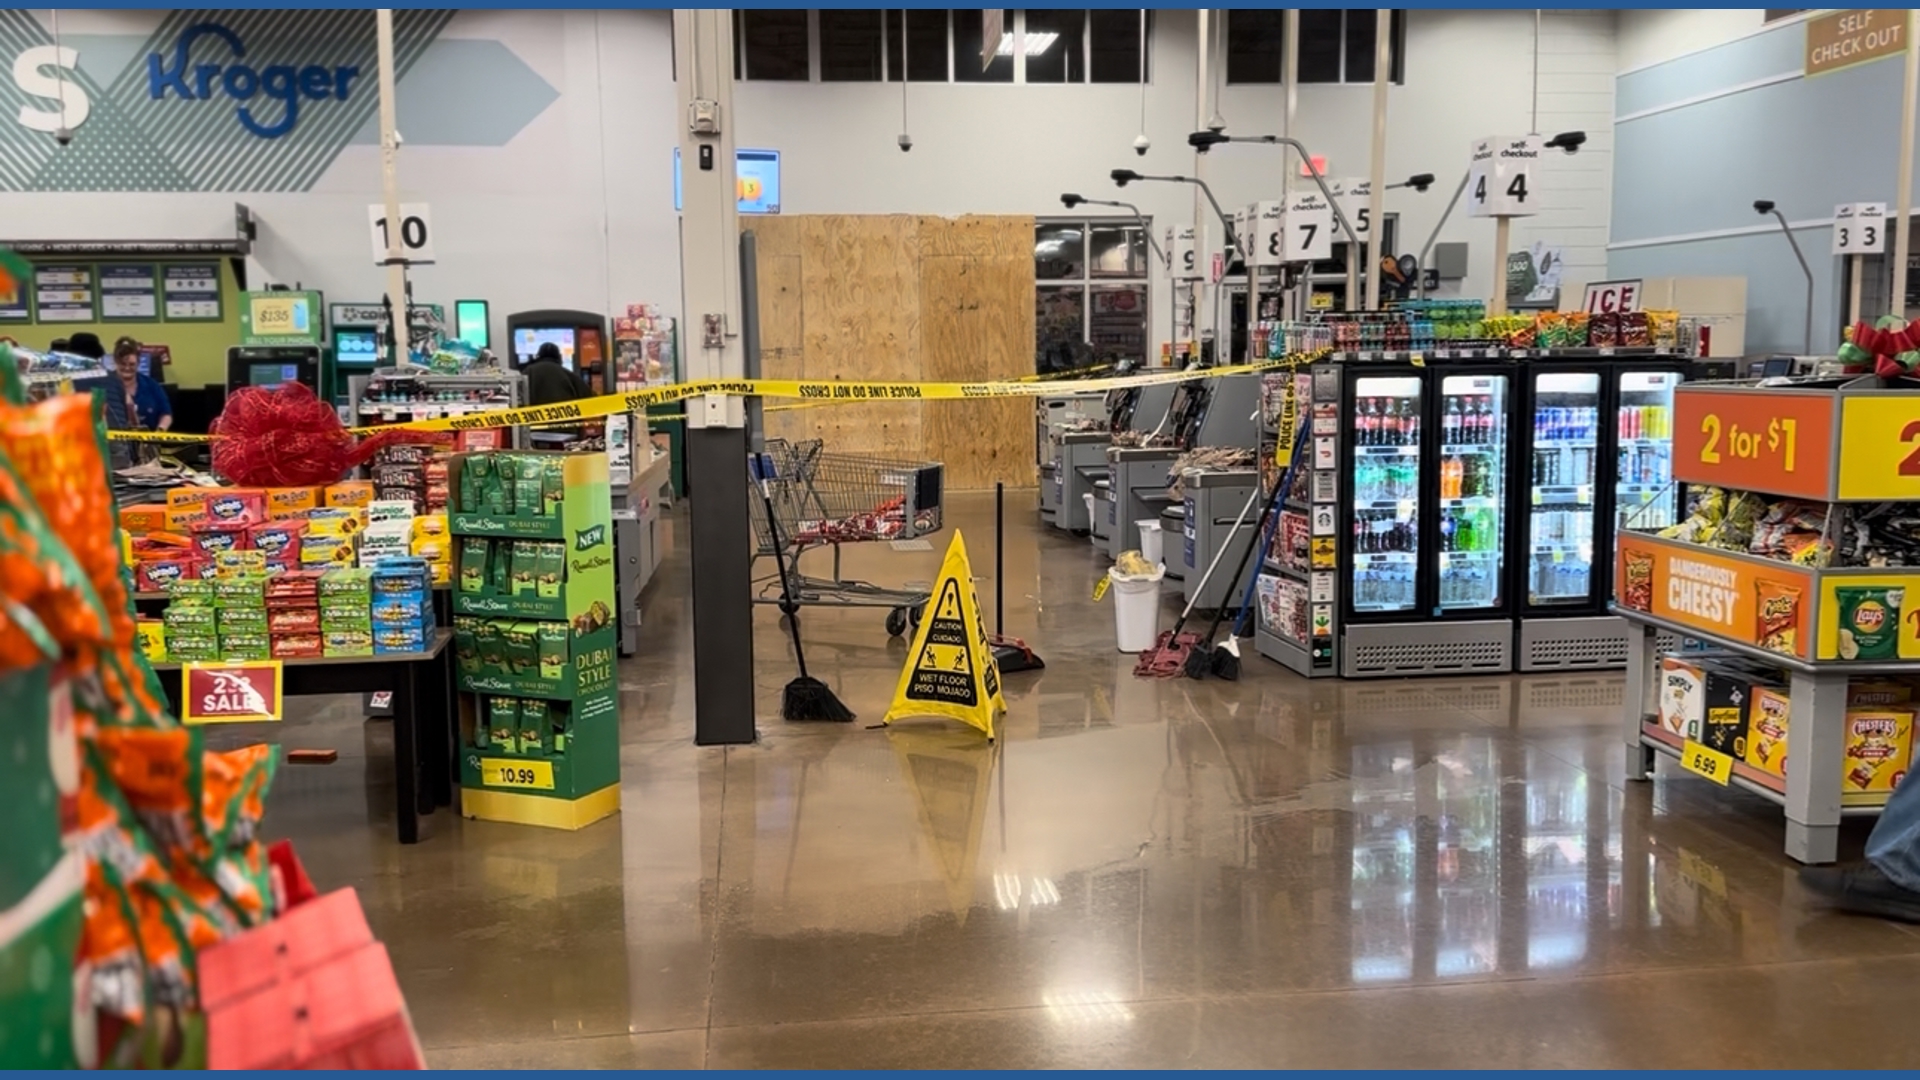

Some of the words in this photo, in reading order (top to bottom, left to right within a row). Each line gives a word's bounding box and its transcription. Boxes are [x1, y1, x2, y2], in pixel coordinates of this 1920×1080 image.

[1838, 10, 1873, 35] SELF
[1811, 36, 1861, 64] CHECK
[1865, 25, 1901, 50] OUT
[148, 22, 359, 139] Kroger
[1500, 149, 1538, 158] checkout
[1475, 174, 1487, 204] 4
[1506, 173, 1528, 203] 4
[1292, 203, 1327, 211] checkout
[1356, 208, 1370, 232] 5
[376, 216, 427, 249] 10
[1299, 224, 1317, 250] 7
[1839, 227, 1849, 247] 3
[1863, 226, 1876, 246] 3
[1588, 285, 1635, 313] ICE
[259, 309, 290, 324] $135
[799, 384, 831, 398] CROSS
[833, 385, 852, 398] NOT
[853, 385, 867, 398] DO
[867, 386, 889, 398] LINE
[889, 386, 922, 398] POLICE
[505, 412, 520, 425] DO
[521, 408, 546, 423] LINE
[545, 404, 582, 420] POLICE
[1283, 400, 1295, 419] LINE
[485, 414, 505, 426] NOT
[1280, 421, 1293, 450] POLICE
[1700, 414, 1721, 464] 2
[1729, 424, 1761, 459] for
[1768, 417, 1796, 472] $1
[370, 506, 405, 515] Junior
[580, 528, 602, 549] NEW
[1670, 556, 1738, 589] DANGEROUSLY
[1669, 576, 1737, 626] CHEESY
[933, 621, 962, 630] CAUTION
[932, 633, 962, 643] CUIDADO
[575, 647, 613, 670] DUBAI
[578, 664, 612, 687] STYLE
[920, 673, 938, 682] WET
[939, 675, 967, 687] FLOOR
[1667, 675, 1694, 693] SIMPLY
[914, 683, 934, 693] PISO
[937, 685, 971, 698] MOJADO
[1693, 753, 1717, 775] 6.99
[500, 767, 535, 784] 10.99
